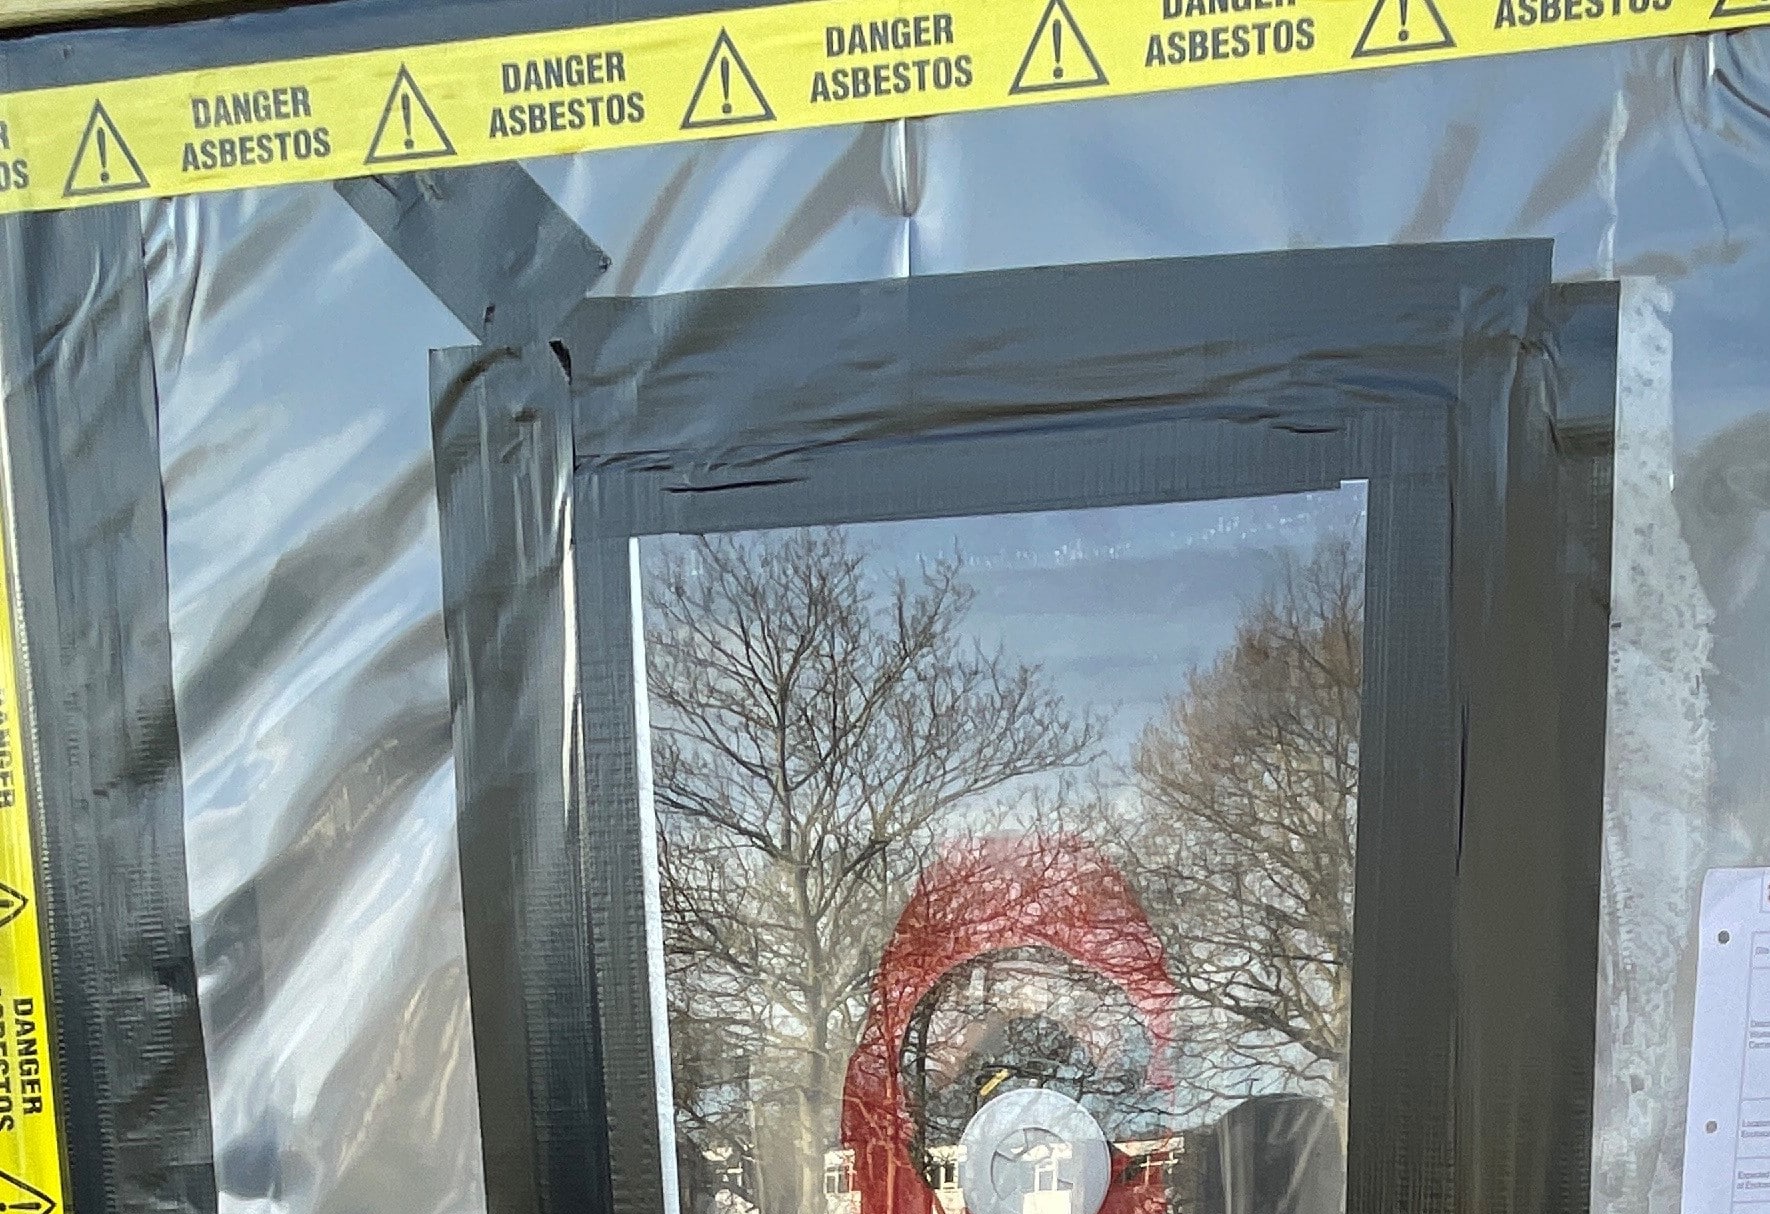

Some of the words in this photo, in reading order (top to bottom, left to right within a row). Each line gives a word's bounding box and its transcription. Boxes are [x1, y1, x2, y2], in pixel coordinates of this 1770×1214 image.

[825, 13, 954, 58] DANGER
[1144, 17, 1316, 68] ASBESTOS
[501, 51, 626, 94] DANGER
[809, 54, 973, 104] ASBESTOS
[191, 85, 312, 130] DANGER
[489, 91, 645, 139] ASBESTOS
[182, 127, 332, 172] ASBESTOS
[13, 998, 43, 1116] DANGER
